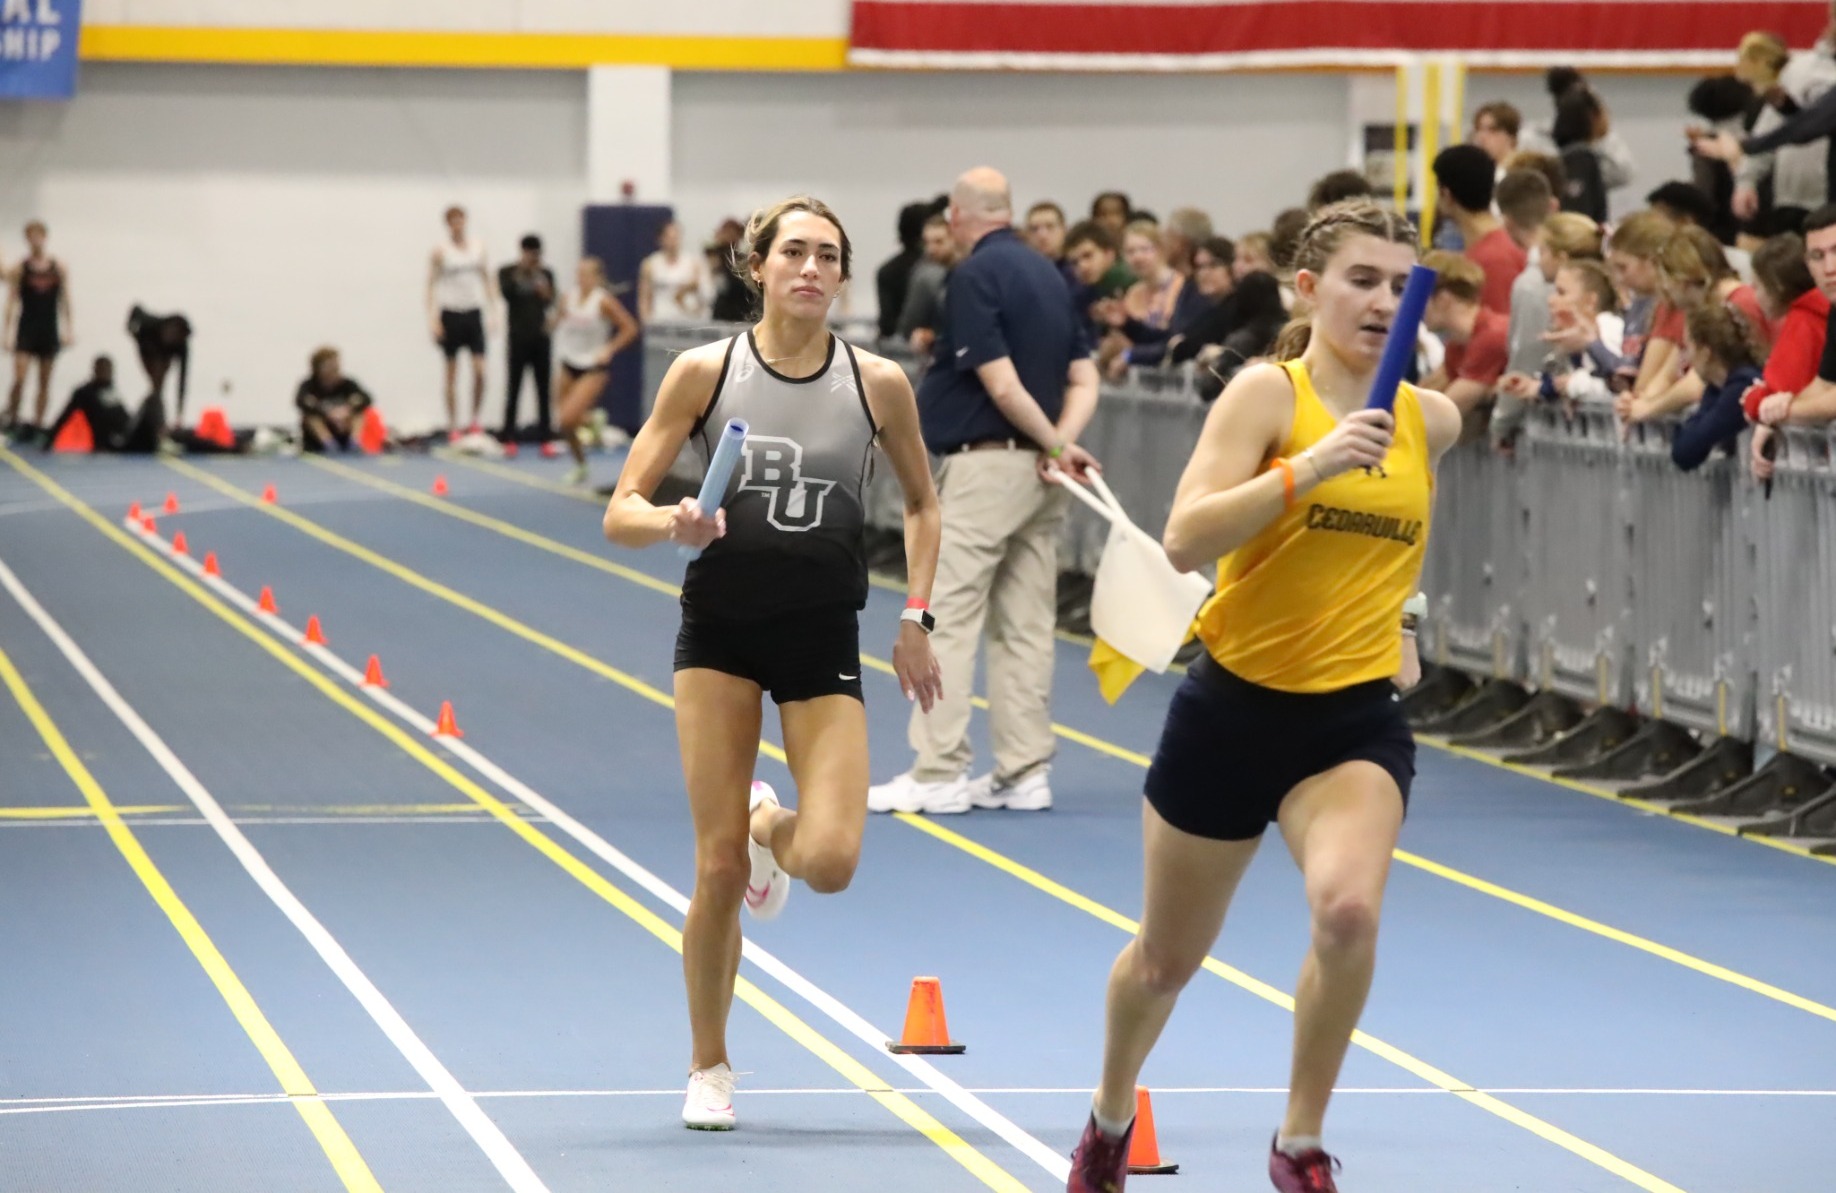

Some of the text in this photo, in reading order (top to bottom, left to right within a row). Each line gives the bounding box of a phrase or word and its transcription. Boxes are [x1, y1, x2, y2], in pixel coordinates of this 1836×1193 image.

[0, 28, 61, 61] HIP
[737, 434, 837, 532] BU
[1307, 503, 1422, 546] CEDARVILLE
